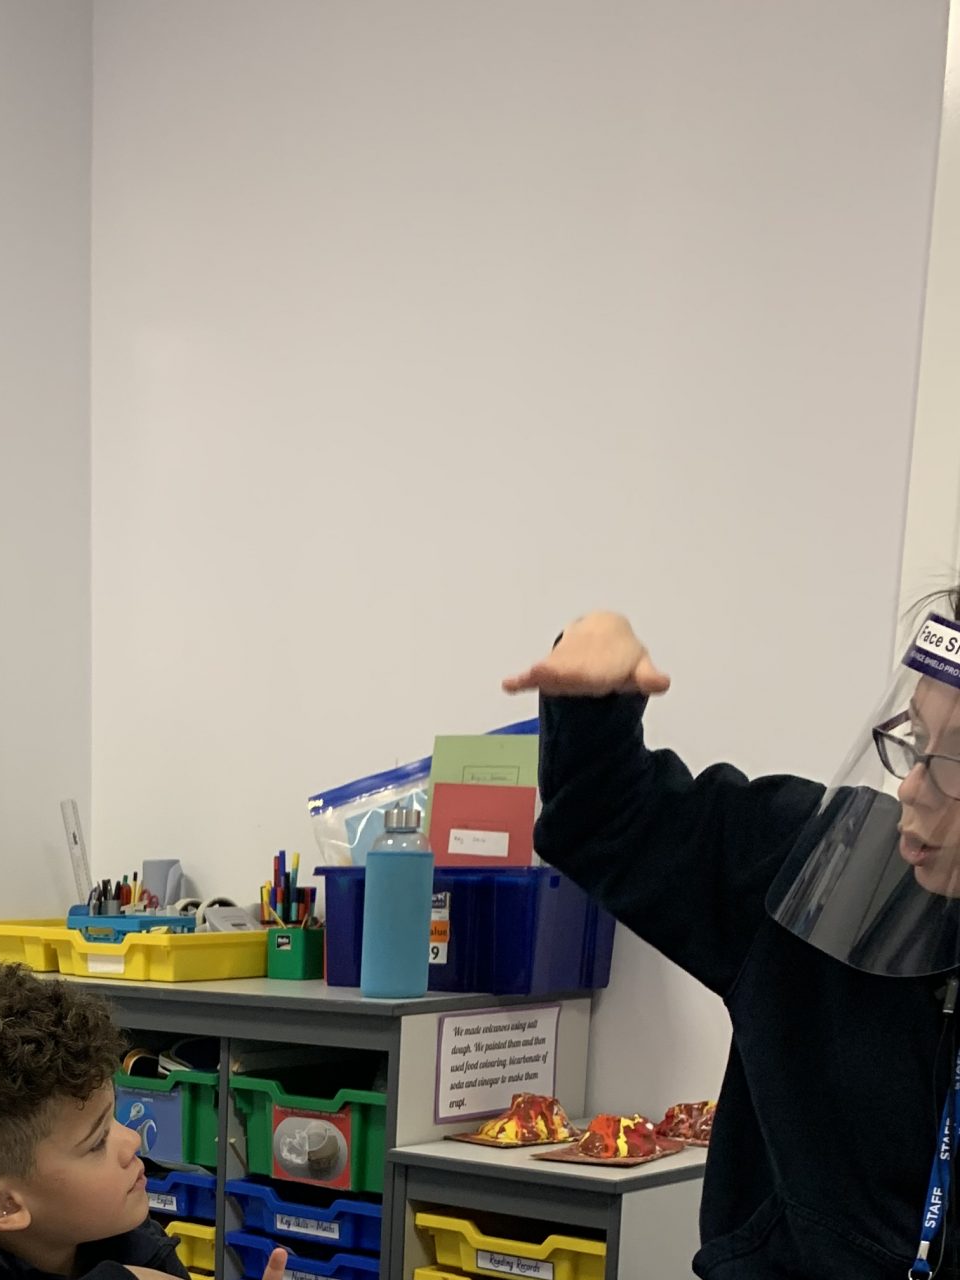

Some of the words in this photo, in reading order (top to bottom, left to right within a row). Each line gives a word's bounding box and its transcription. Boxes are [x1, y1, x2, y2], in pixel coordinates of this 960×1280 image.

[920, 625, 944, 648] Face
[453, 1026, 463, 1036] We
[464, 1025, 481, 1036] made
[482, 1024, 510, 1034] volcanoes
[511, 1021, 526, 1032] using
[527, 1019, 538, 1029] salt
[474, 1042, 484, 1052] We
[484, 1039, 507, 1053] painted
[507, 1038, 521, 1048] them
[522, 1037, 534, 1047] and
[534, 1036, 546, 1045] then
[450, 1061, 464, 1073] used
[464, 1058, 479, 1073] food
[509, 1054, 541, 1066] bicarbonate
[541, 1051, 549, 1064] of
[450, 1080, 464, 1090] soda
[465, 1078, 477, 1088] and
[477, 1076, 500, 1088] vinegar
[501, 1074, 507, 1082] to
[508, 1072, 524, 1083] make
[524, 1070, 539, 1080] them
[924, 1186, 944, 1228] STAFF
[489, 1254, 513, 1271] Reading
[516, 1258, 540, 1273] Records
